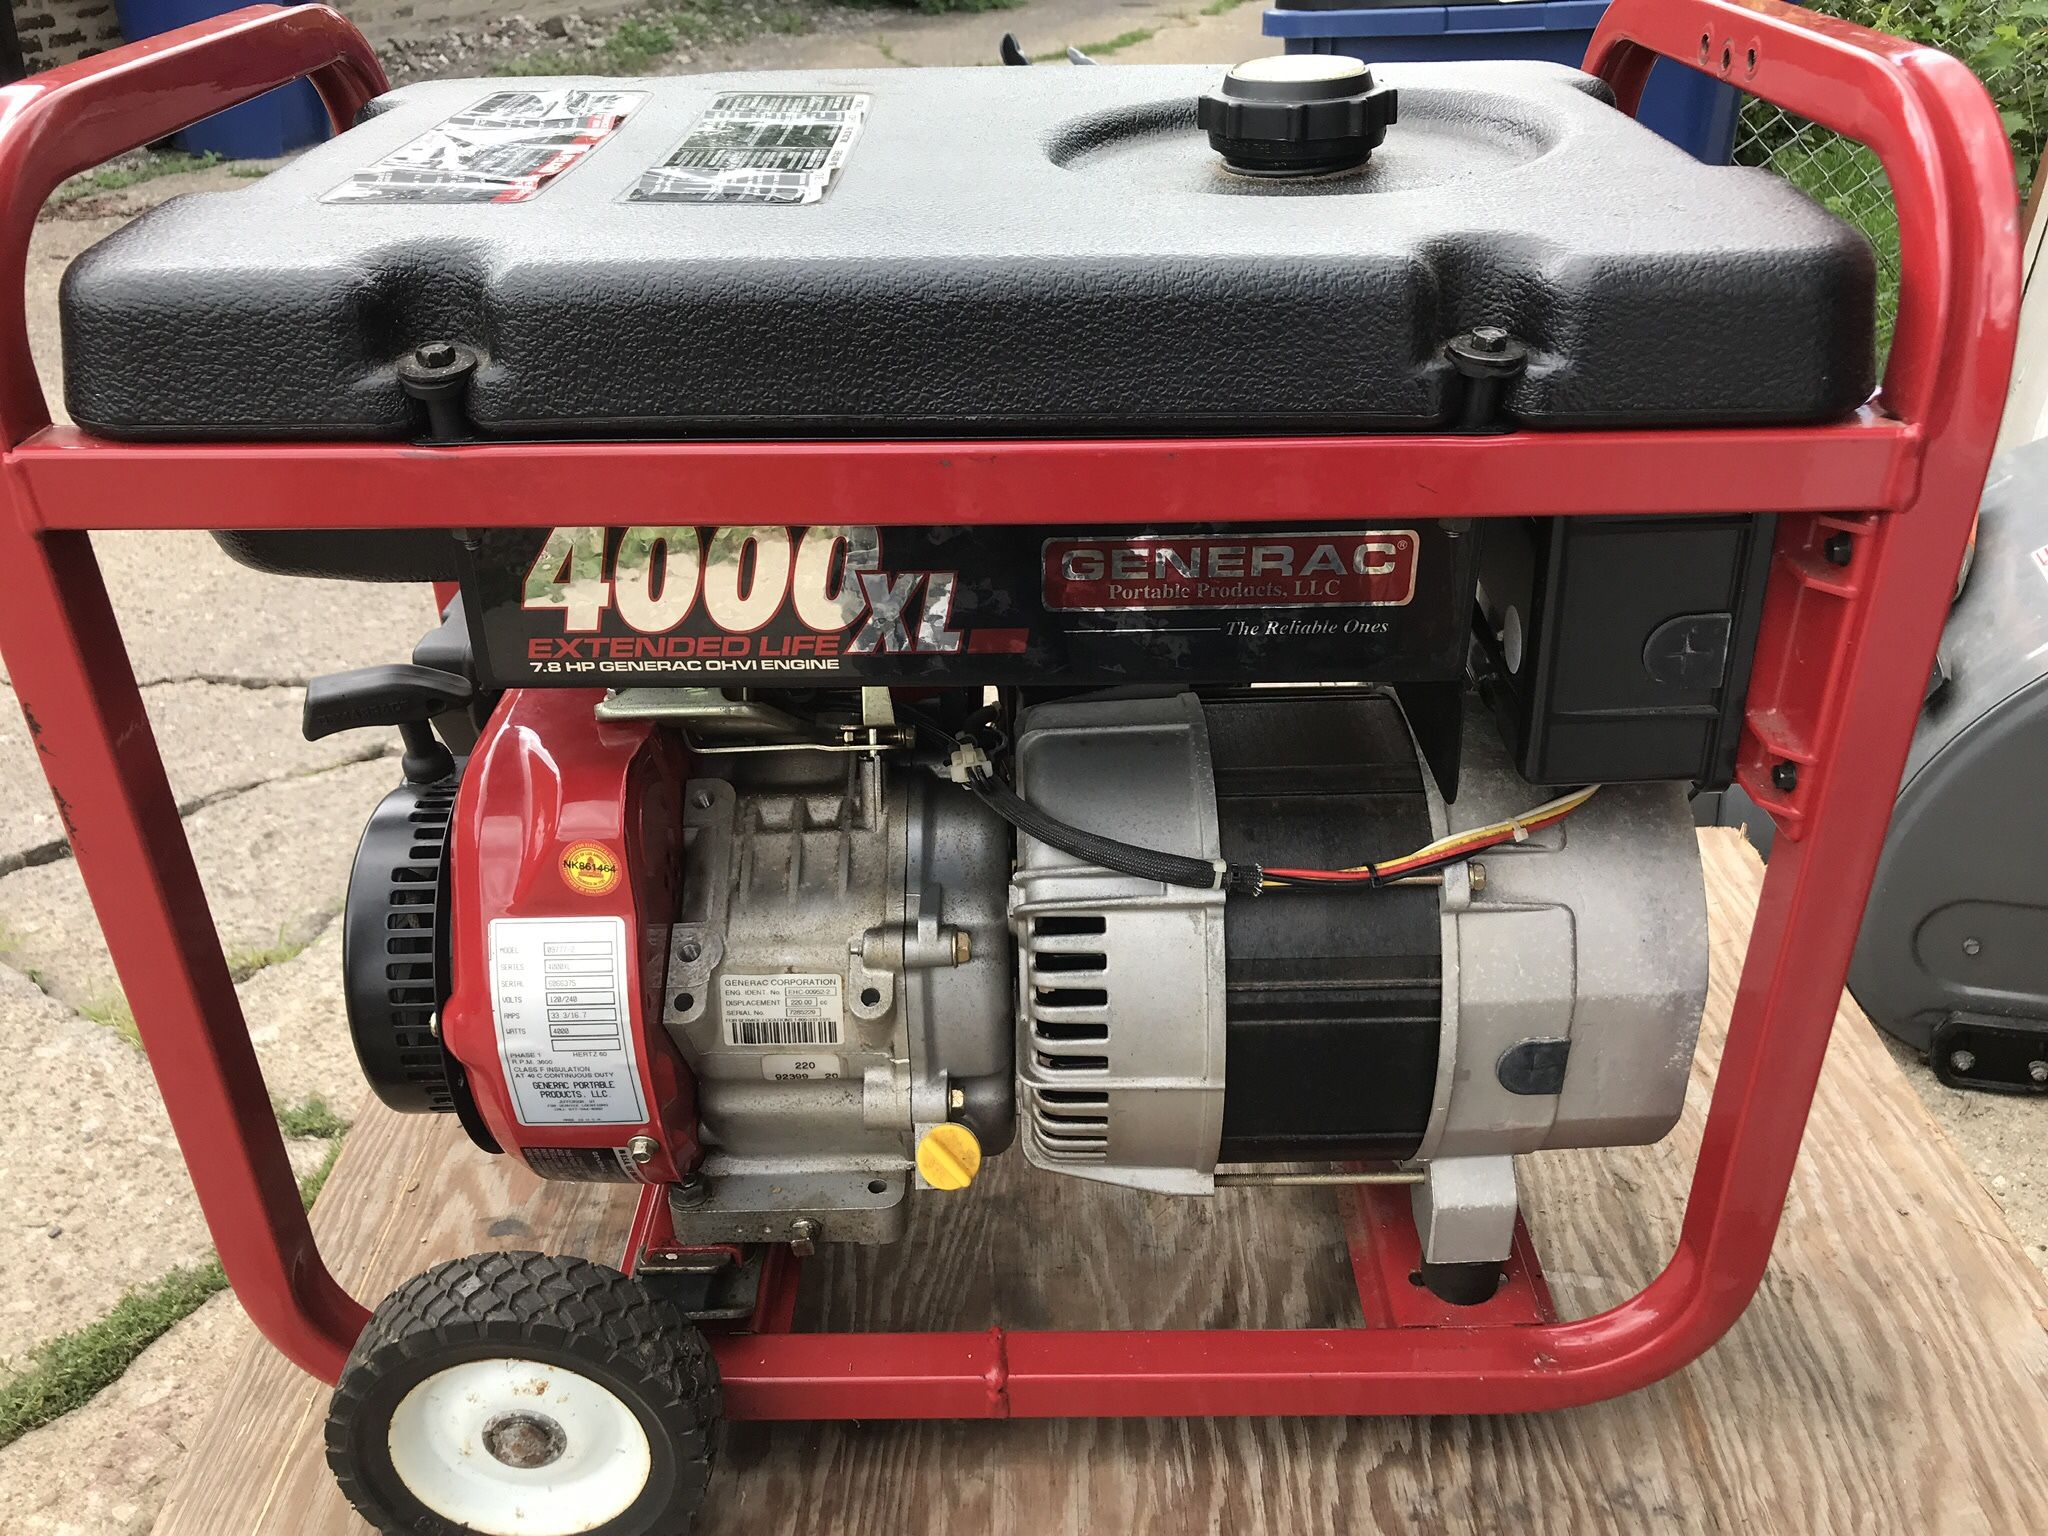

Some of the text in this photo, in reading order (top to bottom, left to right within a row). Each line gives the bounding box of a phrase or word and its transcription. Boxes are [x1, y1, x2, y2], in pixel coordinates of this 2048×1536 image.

[1060, 542, 1397, 581] GENERAC
[1108, 580, 1342, 600] Portable Products, LLC
[1225, 619, 1390, 637] The Reliable Ones
[527, 635, 841, 659] EXTENDED LIFE
[529, 659, 840, 674] 7.8 HP GENERAC OHVI ENGINE
[563, 860, 617, 873] NK861464
[724, 978, 836, 987] GENERAC CORPORATION
[502, 996, 522, 1004] VOLTS
[504, 1012, 520, 1020] AMPS
[573, 1081, 616, 1089] PORTABLE
